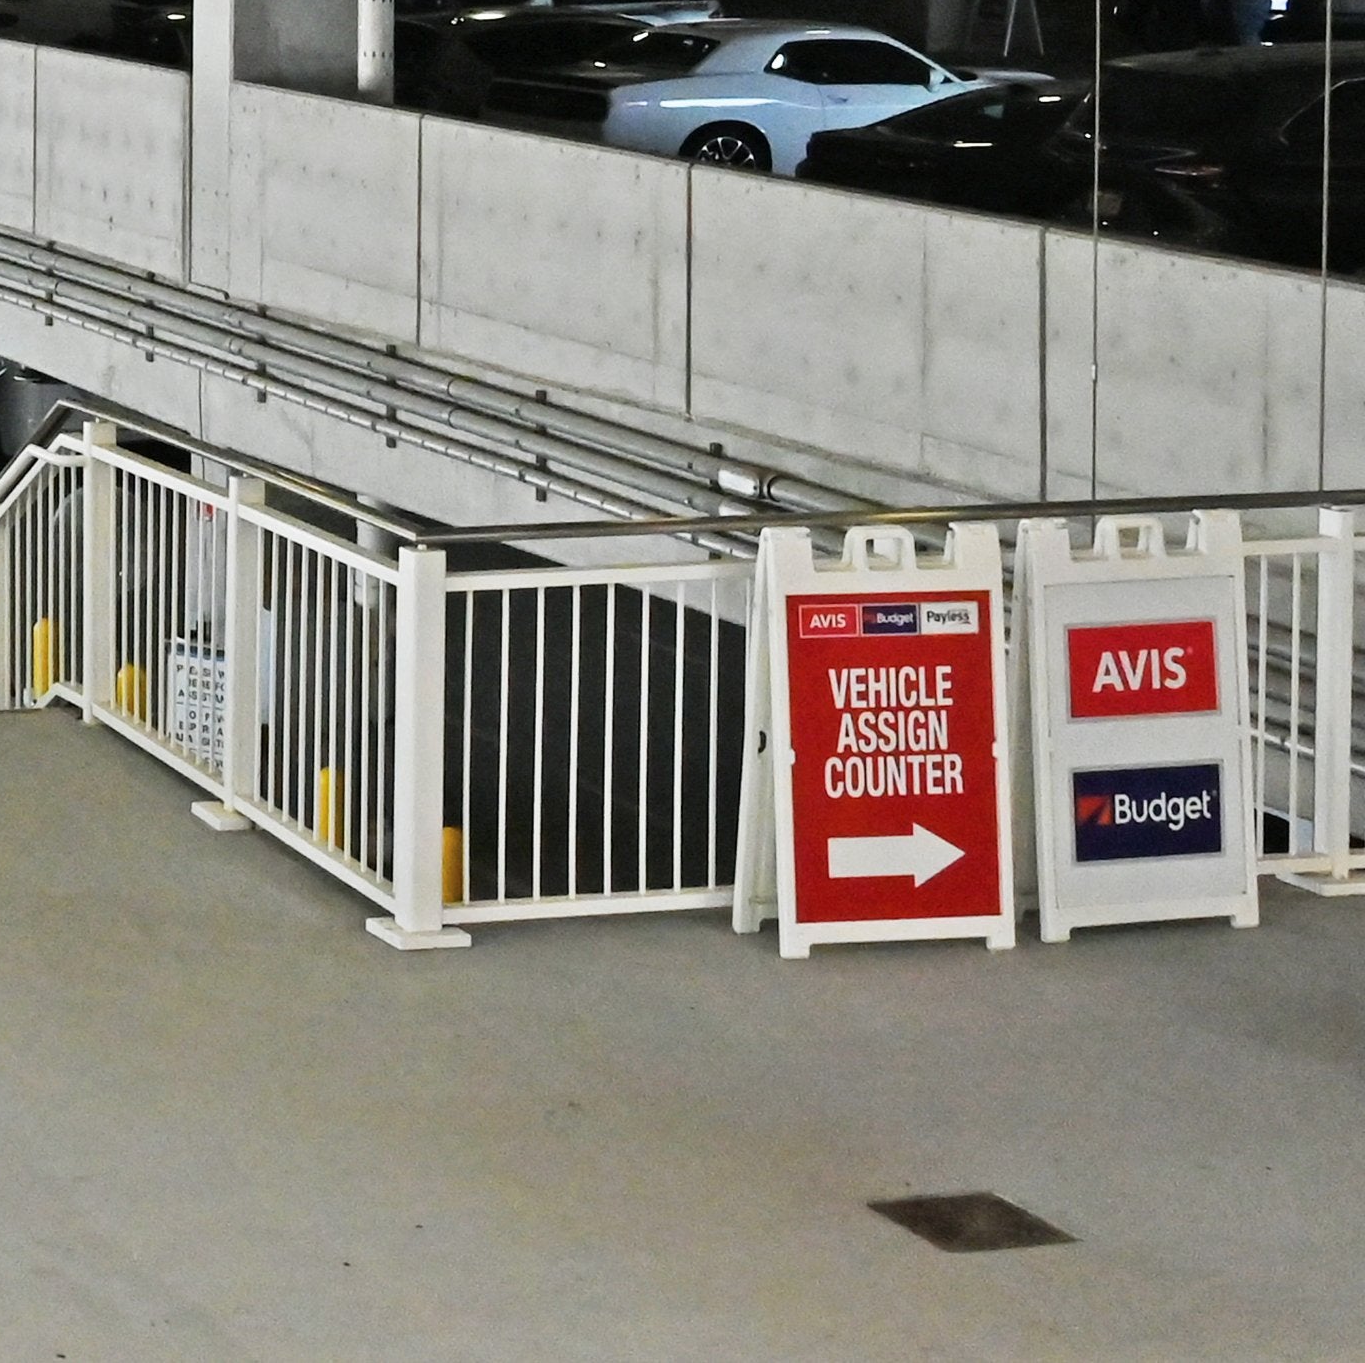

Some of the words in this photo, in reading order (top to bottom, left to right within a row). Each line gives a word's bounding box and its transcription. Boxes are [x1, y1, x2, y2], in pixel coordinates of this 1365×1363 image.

[809, 613, 846, 629] AVIS
[876, 612, 914, 627] Budget
[926, 610, 972, 625] Payless
[828, 664, 953, 711] VEHICLE
[1091, 646, 1189, 693] AVIS
[836, 710, 949, 754] ASSIGN
[824, 753, 965, 799] COUNTER
[1113, 790, 1212, 832] Budget
